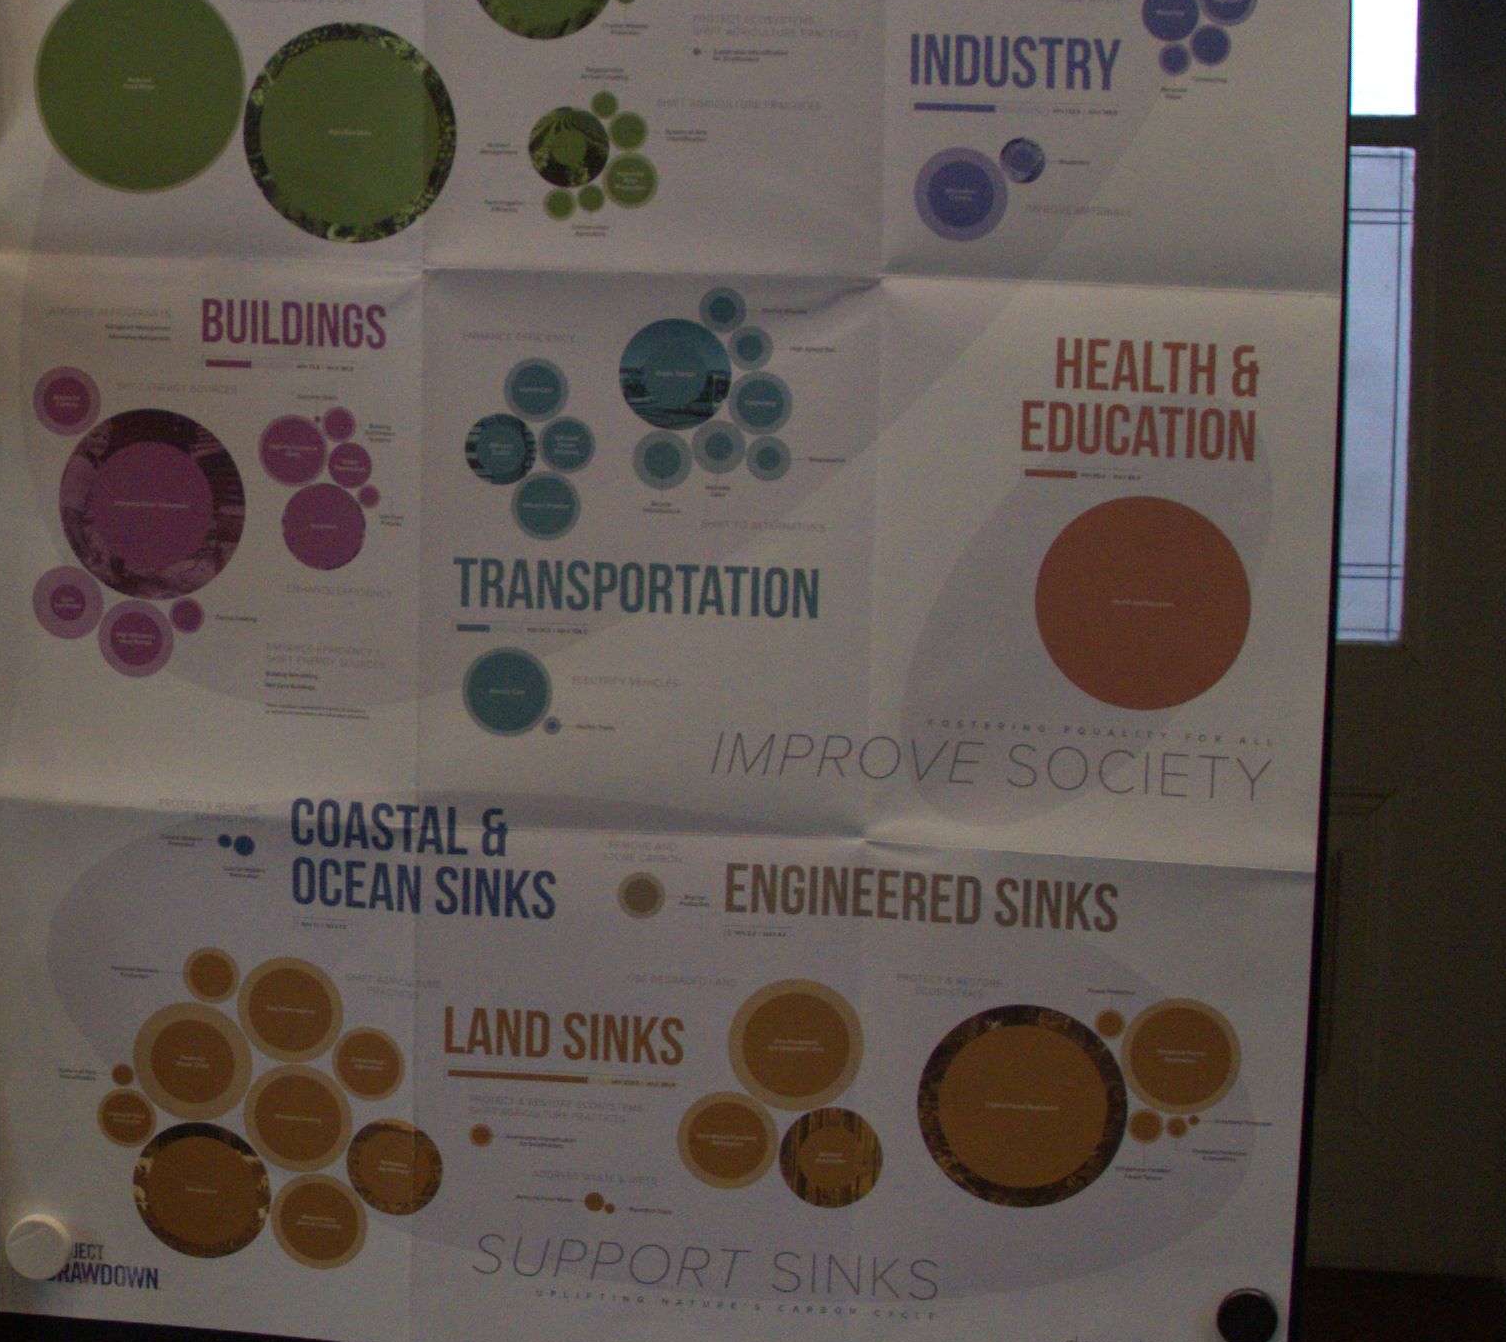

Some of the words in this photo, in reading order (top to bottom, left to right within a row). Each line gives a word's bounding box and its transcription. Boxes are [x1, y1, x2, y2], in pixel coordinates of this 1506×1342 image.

[910, 33, 1122, 92] INDUSTRY
[201, 298, 387, 350] BUILDINGS
[1055, 337, 1216, 396] HEALTH
[1233, 345, 1259, 397] &
[1022, 401, 1256, 461] EDUCATION
[453, 557, 820, 619] TRANSPORTATION
[710, 730, 985, 786] IMPROVE
[1006, 744, 1274, 802] SOCIETY
[1184, 732, 1222, 744] FOR
[1239, 736, 1275, 746] ALL
[291, 798, 467, 855] COASTAL
[482, 808, 508, 856] &
[291, 856, 420, 913] OCEAN
[435, 866, 557, 920] SINKS
[724, 863, 981, 926] ENGINEERED
[994, 877, 1119, 933] SINKS
[443, 1006, 552, 1058] LAND
[563, 1012, 684, 1066] SINKS
[47, 1261, 158, 1289] RAWDOWN
[73, 1243, 103, 1259] JECT
[473, 1232, 752, 1288] SUPPORT
[771, 1250, 939, 1301] SINKS
